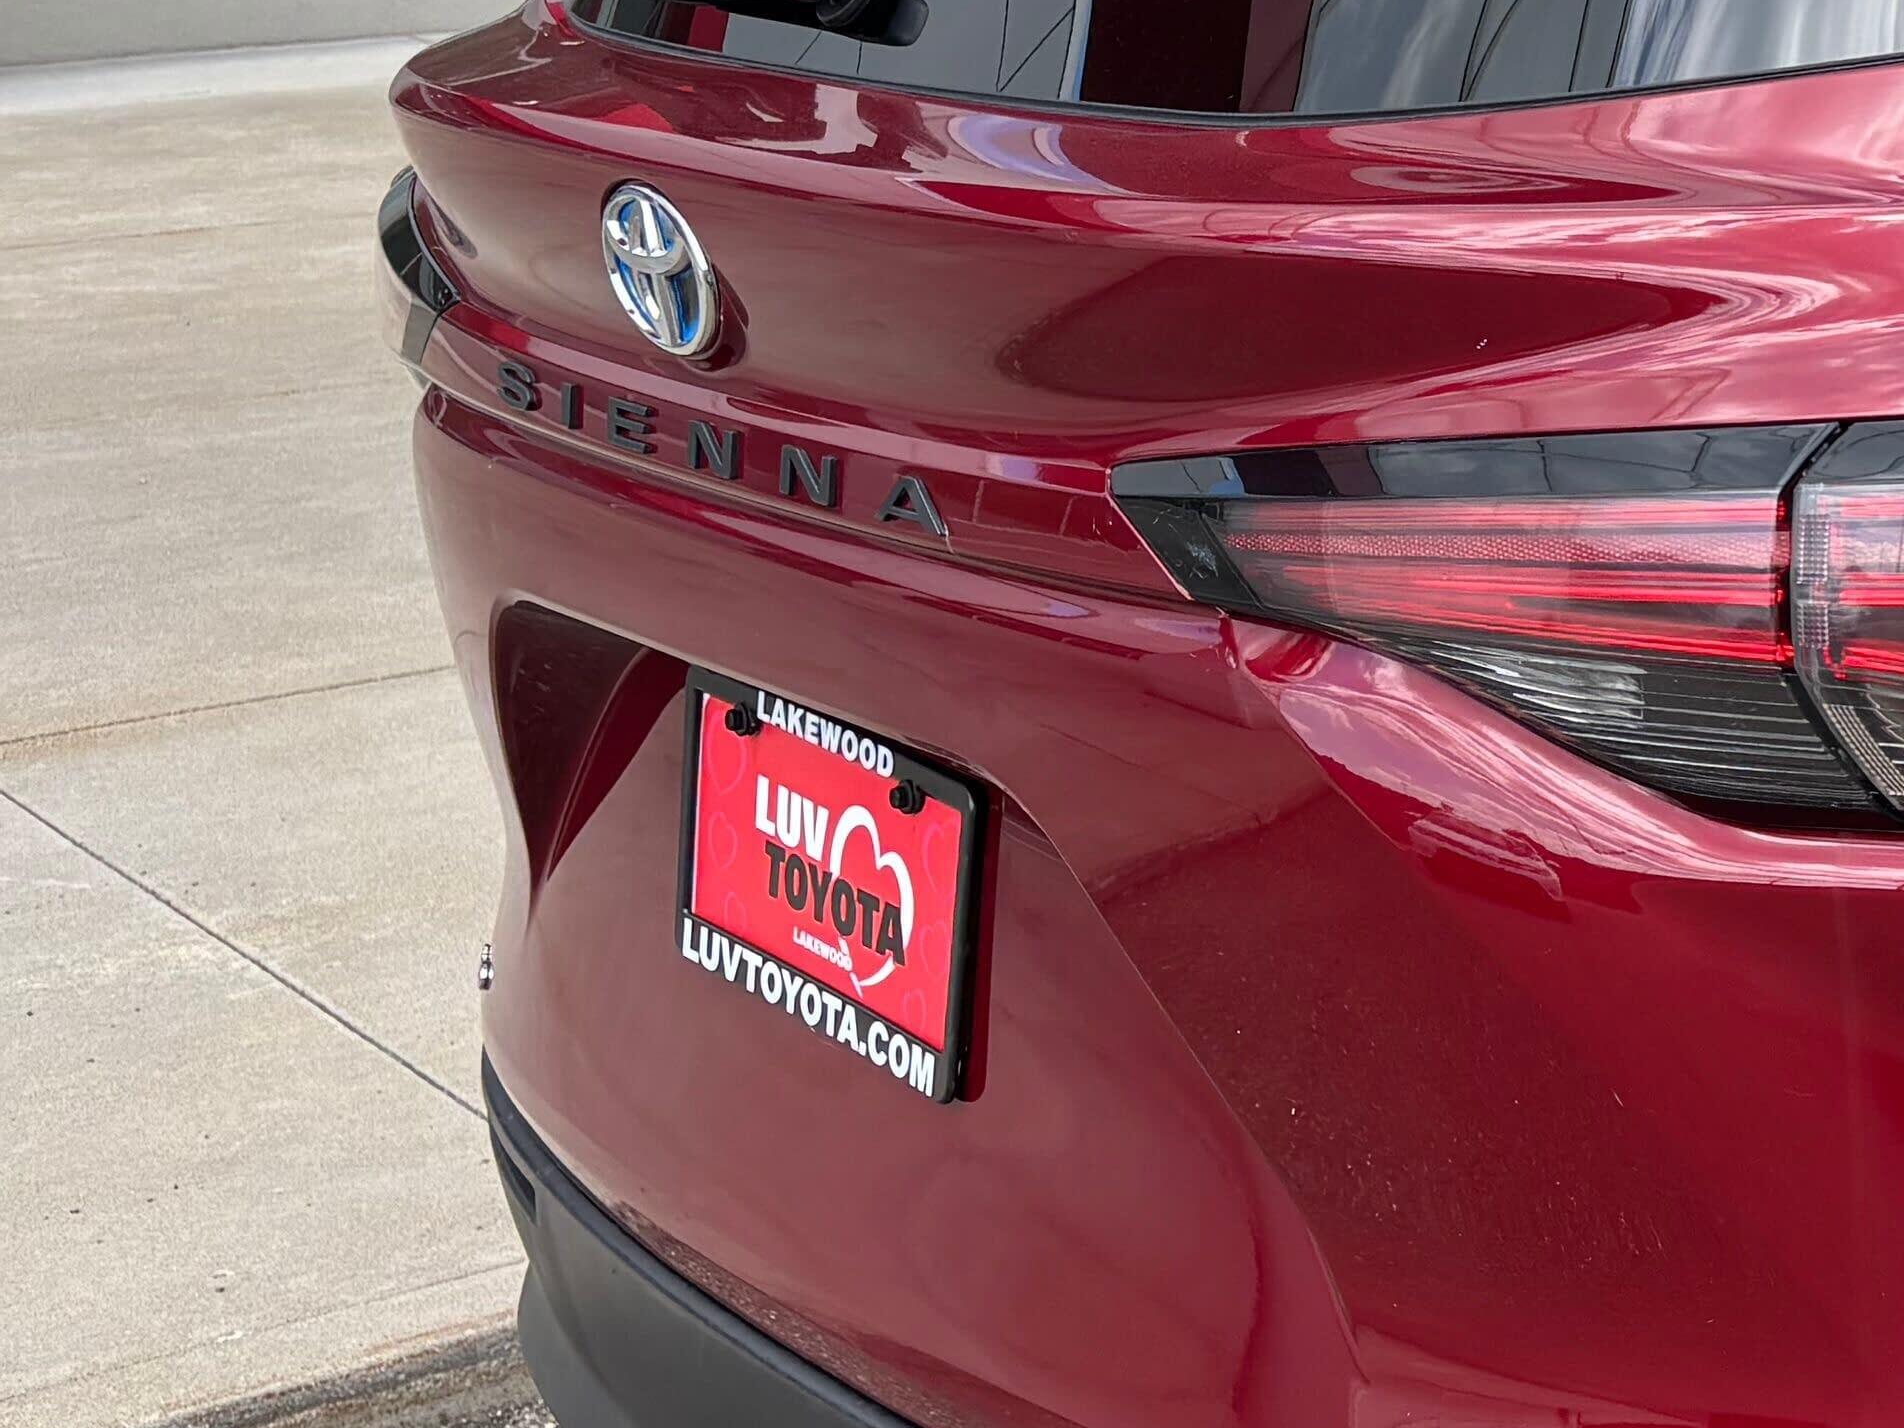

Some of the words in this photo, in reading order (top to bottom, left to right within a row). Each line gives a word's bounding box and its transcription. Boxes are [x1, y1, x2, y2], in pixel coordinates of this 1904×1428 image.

[497, 362, 950, 538] SIENNA
[756, 691, 896, 779] LAKEWOOD
[755, 775, 829, 862] LUV
[764, 840, 907, 967] TOYOTA
[792, 925, 854, 973] LAKEWOOD
[681, 917, 936, 1098] LUVTOYOTA.COM
